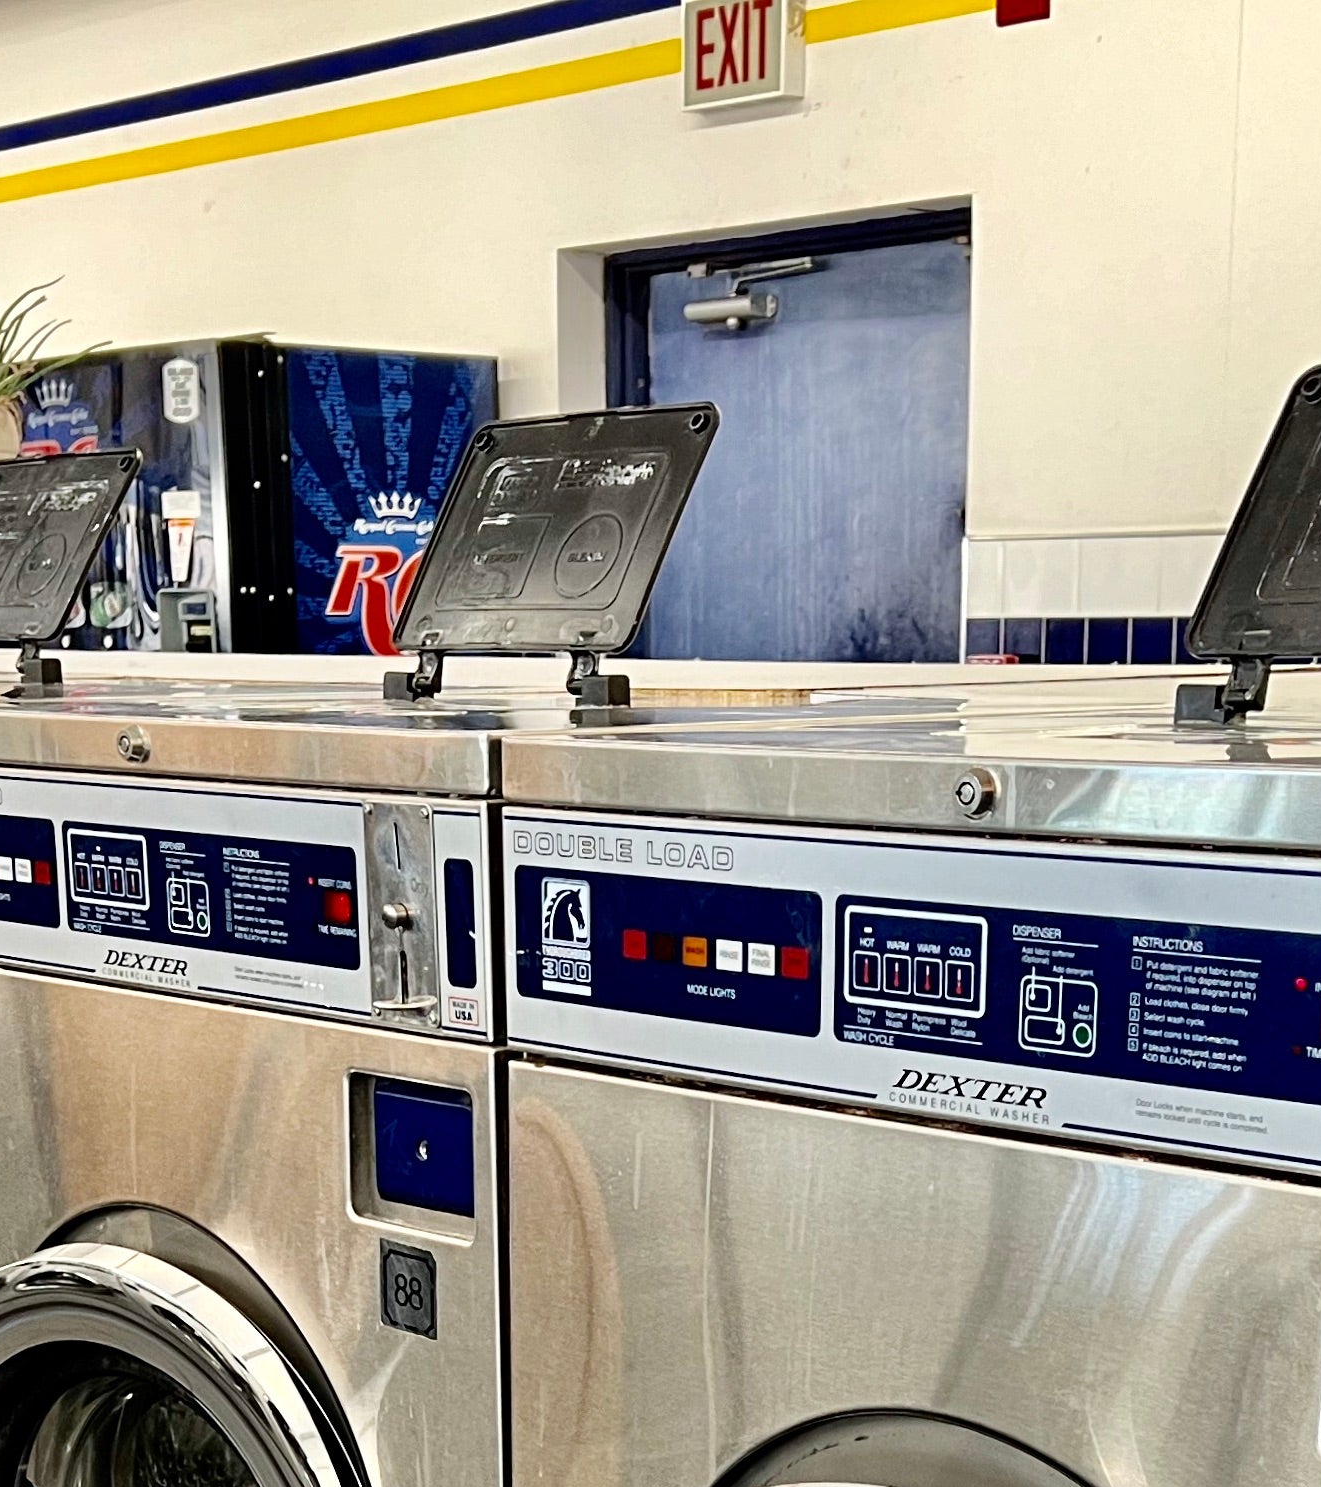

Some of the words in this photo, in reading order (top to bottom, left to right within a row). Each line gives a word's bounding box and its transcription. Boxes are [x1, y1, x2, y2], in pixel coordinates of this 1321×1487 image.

[696, 0, 773, 91] EXIT
[513, 830, 633, 863] DOUBLE
[646, 840, 734, 871] LOAD
[1012, 924, 1062, 939] DISPENSER
[859, 937, 875, 948] HOT
[886, 940, 910, 951] WARM
[917, 943, 941, 955] WARM
[1132, 936, 1204, 952] INSTRUCTIONS
[751, 948, 770, 959] FINAL
[948, 945, 972, 958] COLD
[103, 949, 189, 977] DEXTER
[542, 957, 592, 983] 300
[101, 966, 154, 983] COMMERCIAL
[157, 974, 191, 989] WASHER
[687, 984, 708, 996] MODE
[709, 986, 736, 999] LIGHTS
[454, 1010, 473, 1022] USA
[950, 1018, 968, 1028] Wool
[843, 1029, 867, 1042] WASH
[868, 1032, 895, 1046] CYCLE
[1142, 1052, 1159, 1063] ADD
[1159, 1054, 1191, 1066] BLEACH
[1207, 1062, 1231, 1072] comes
[1232, 1065, 1243, 1073] on
[892, 1068, 1048, 1109] DEXTER
[888, 1091, 981, 1115] COMMERCIAL
[989, 1106, 1051, 1125] WASHER
[394, 1272, 423, 1311] 88
